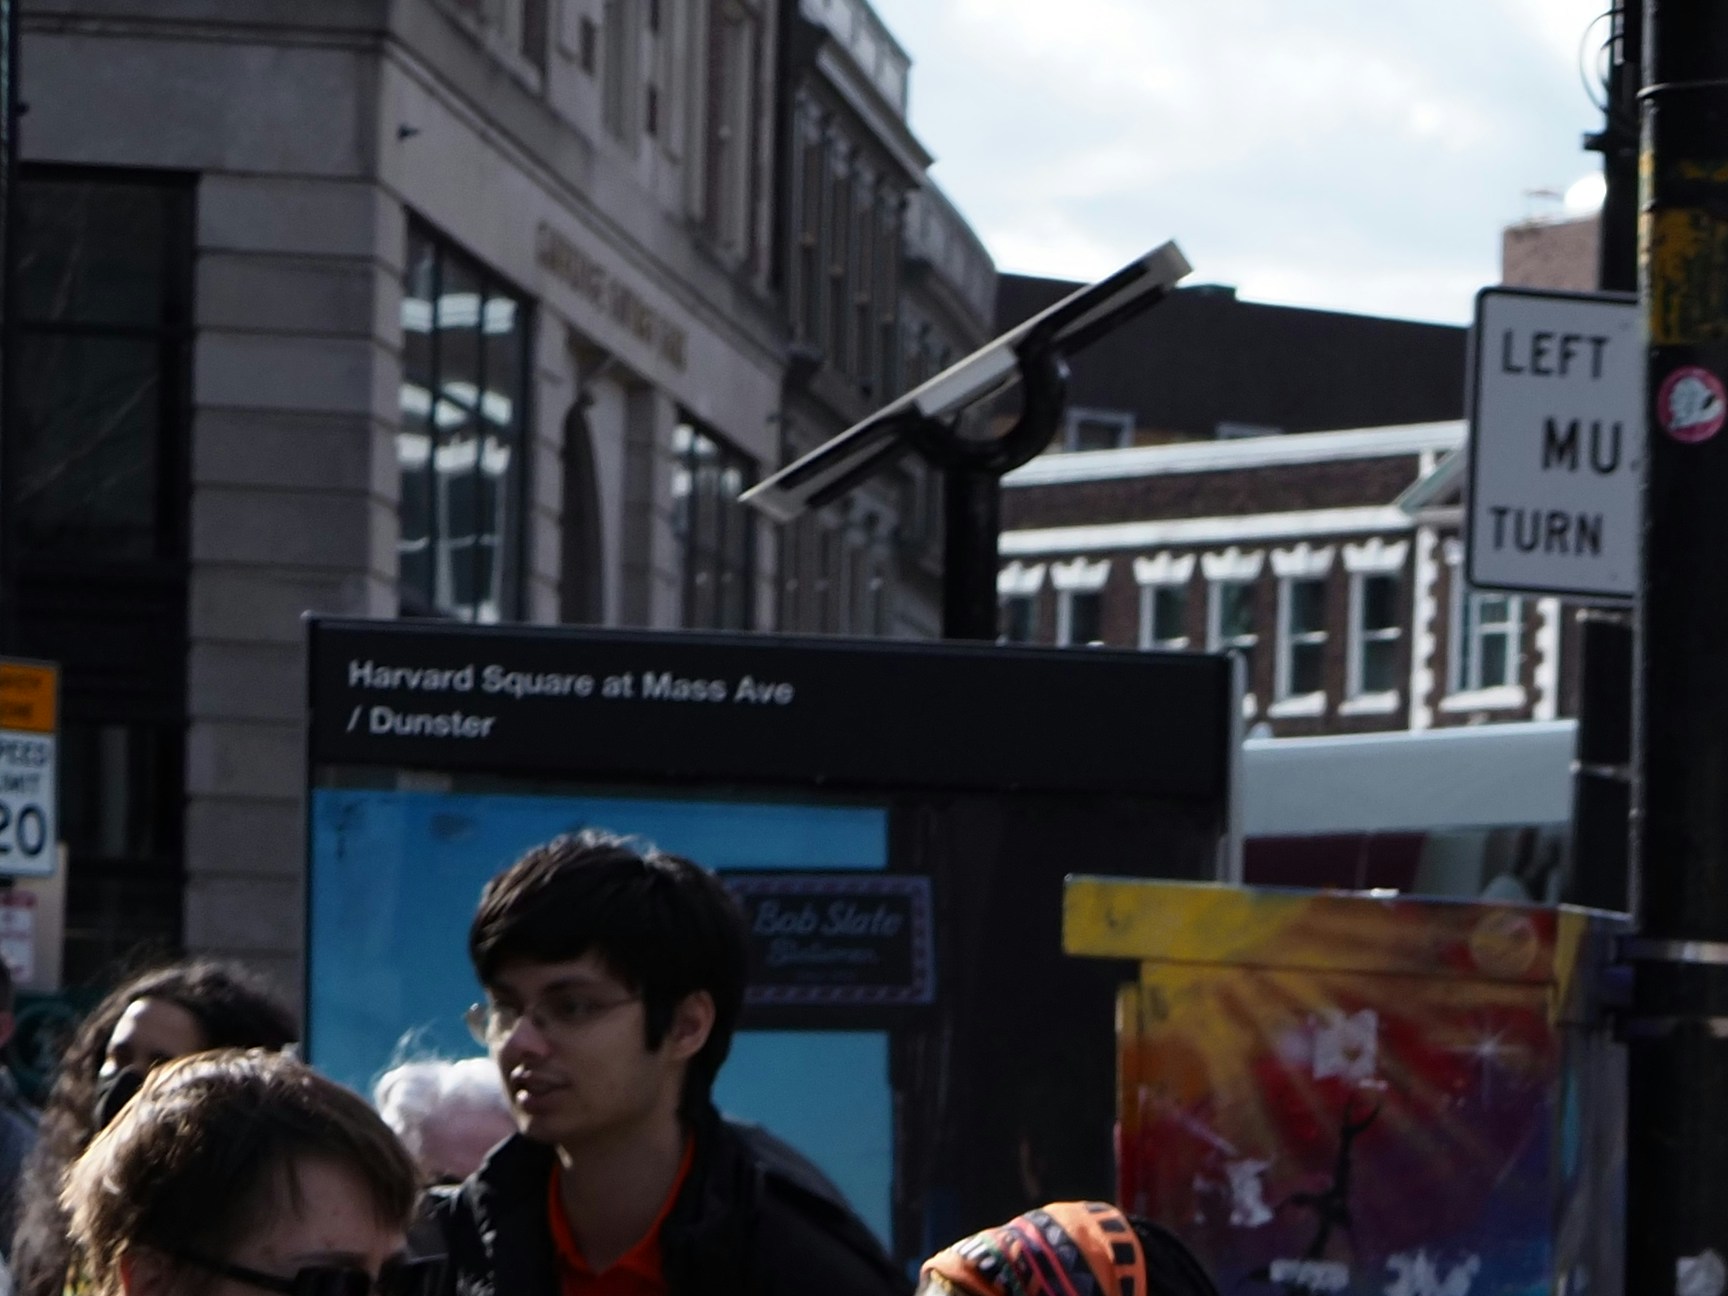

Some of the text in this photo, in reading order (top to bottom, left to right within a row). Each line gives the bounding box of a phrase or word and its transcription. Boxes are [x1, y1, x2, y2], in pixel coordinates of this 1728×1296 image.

[1501, 328, 1611, 379] LEFT
[1540, 415, 1640, 475] MU
[1489, 505, 1604, 557] TURN
[347, 658, 795, 705] Harvard Square at Mass Ave
[369, 705, 496, 739] Dunster
